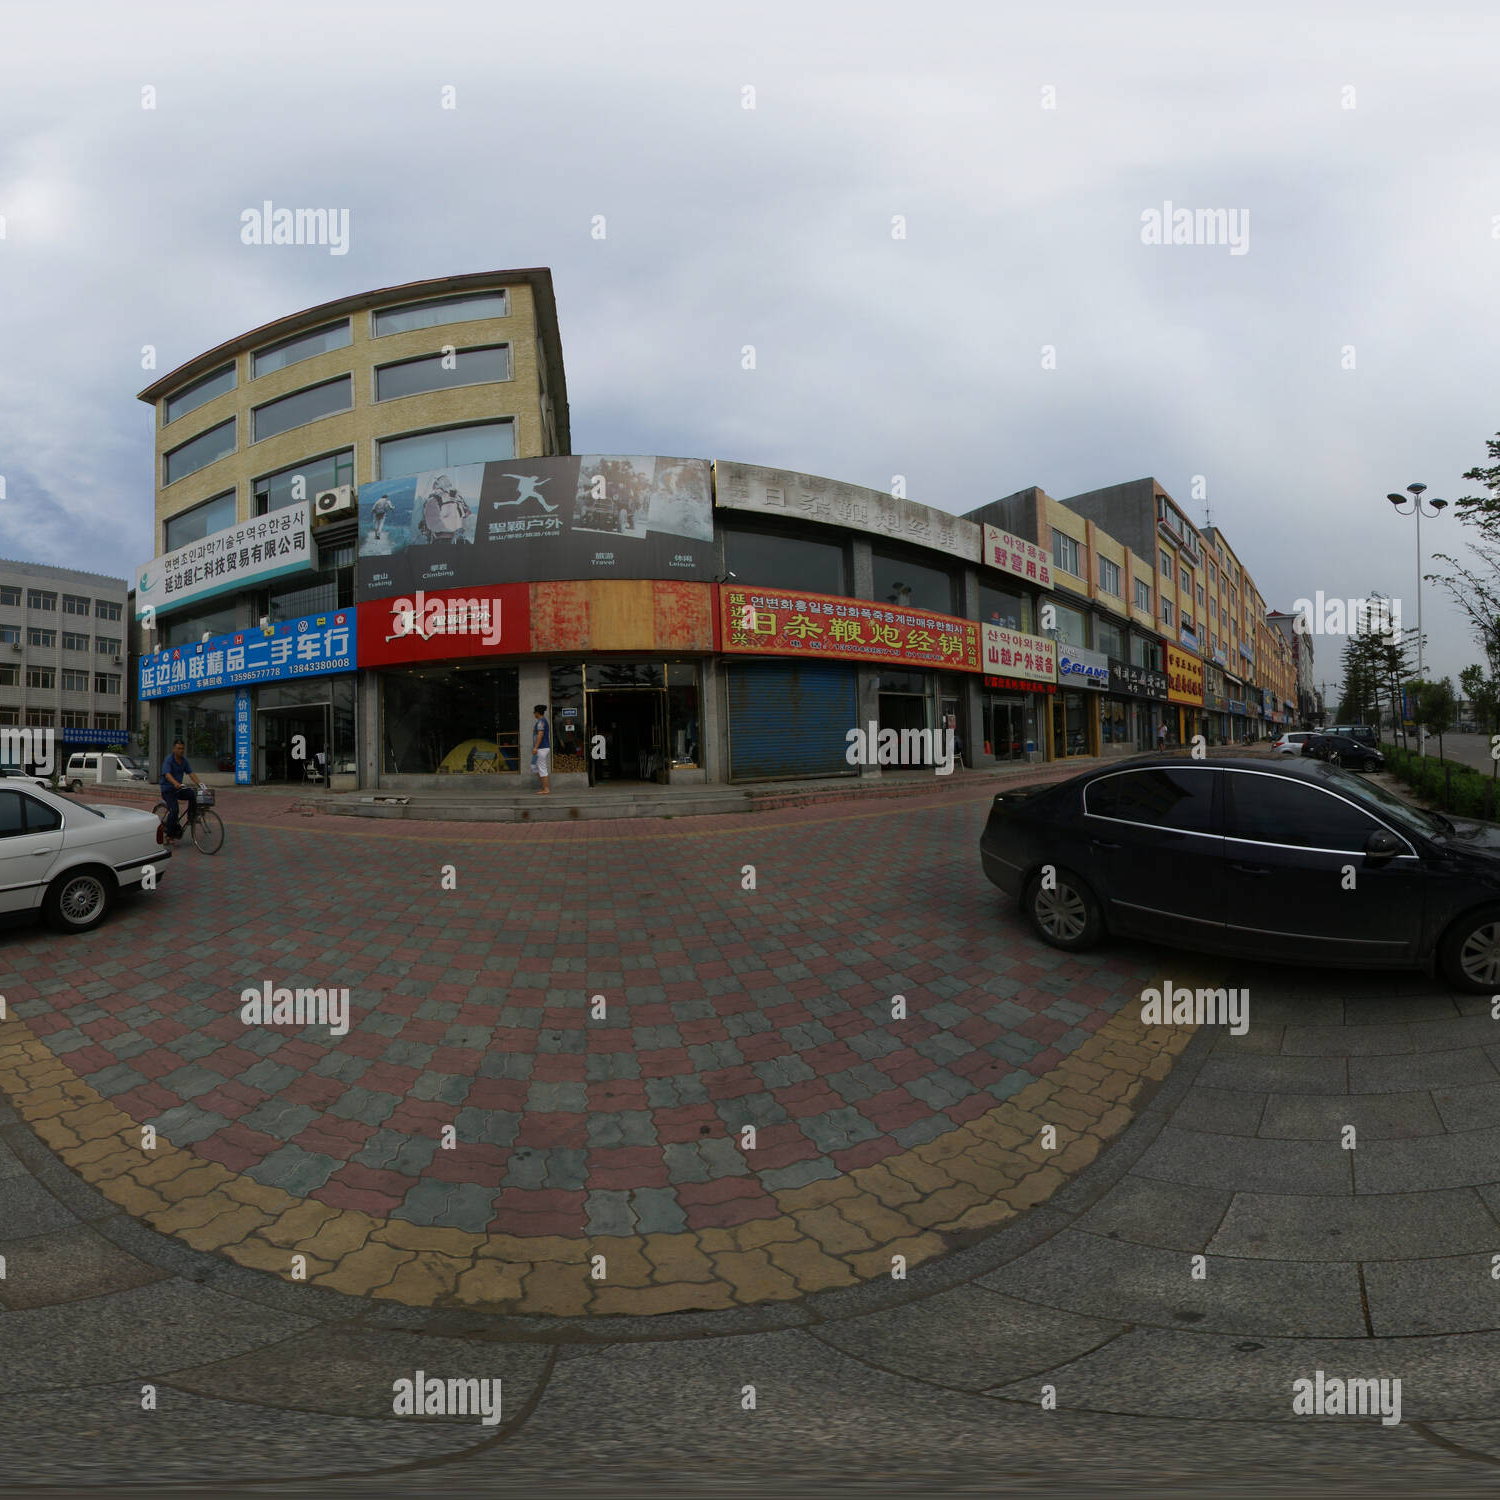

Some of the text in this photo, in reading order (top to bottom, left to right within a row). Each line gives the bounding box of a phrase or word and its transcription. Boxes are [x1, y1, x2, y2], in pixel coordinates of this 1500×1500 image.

[164, 530, 306, 595] 延边超仁科技贸易有限公司
[422, 570, 454, 579] Climbing
[994, 546, 1050, 585] 野营用品
[753, 612, 964, 658] 日杂鞭炮经销
[966, 625, 978, 667] 有限公司
[141, 626, 350, 690] 延边纵联精品二手车行
[288, 657, 350, 675] 13843380008
[1071, 662, 1108, 679] GIANT
